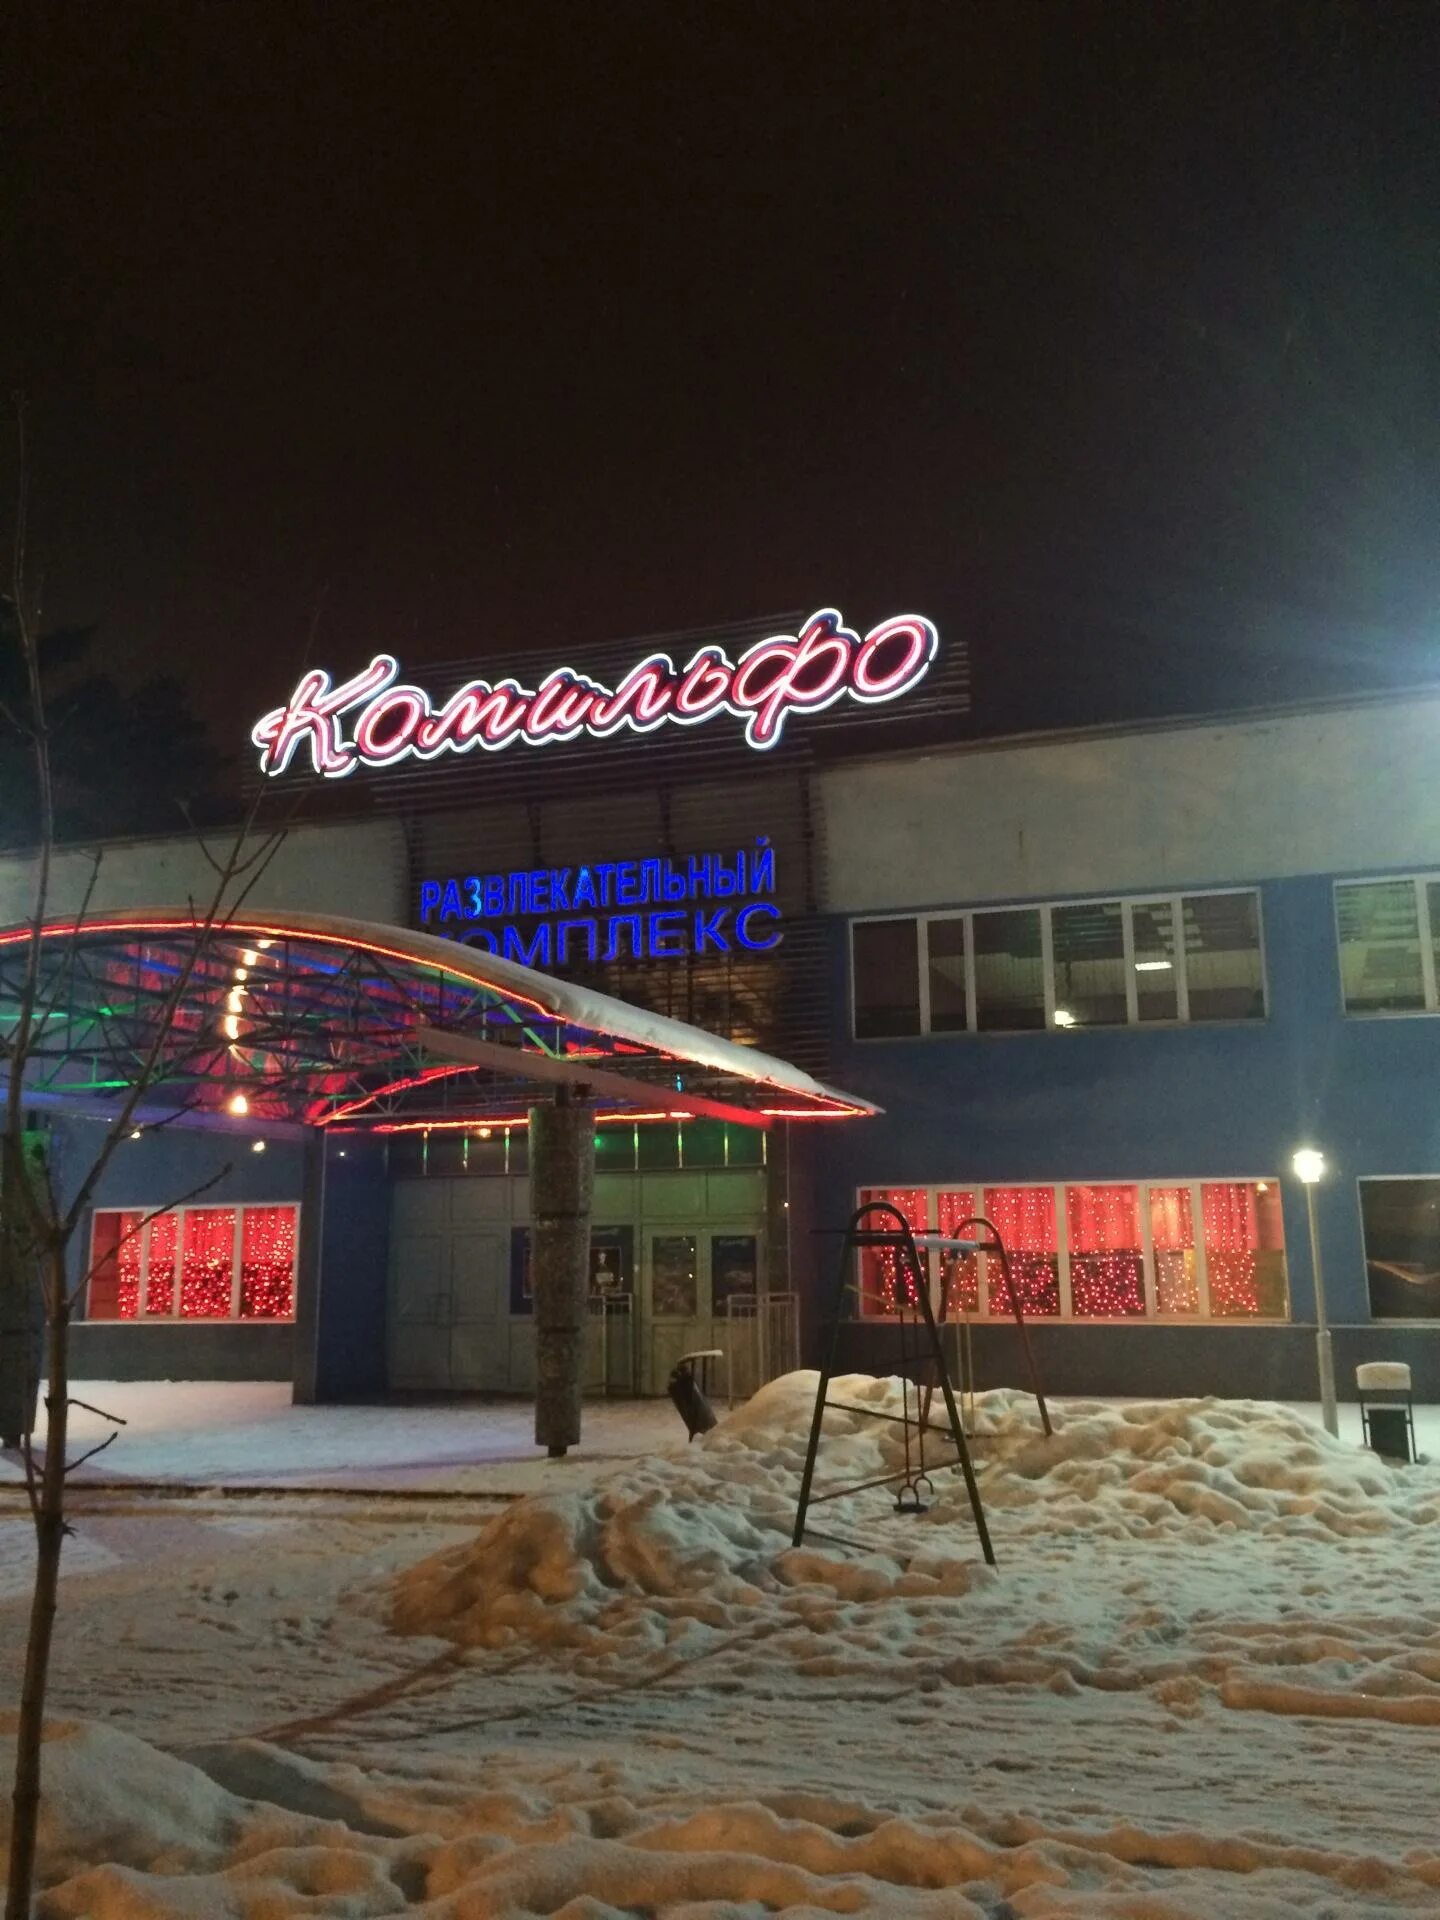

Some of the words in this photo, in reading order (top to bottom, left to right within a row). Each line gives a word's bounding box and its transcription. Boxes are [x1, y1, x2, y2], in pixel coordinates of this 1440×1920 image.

[251, 607, 940, 776] Комильфо
[421, 836, 775, 923] РАЗВЛЕКАТЕЛЬНЫЙ
[440, 903, 784, 966] ОМПЛЕКС
